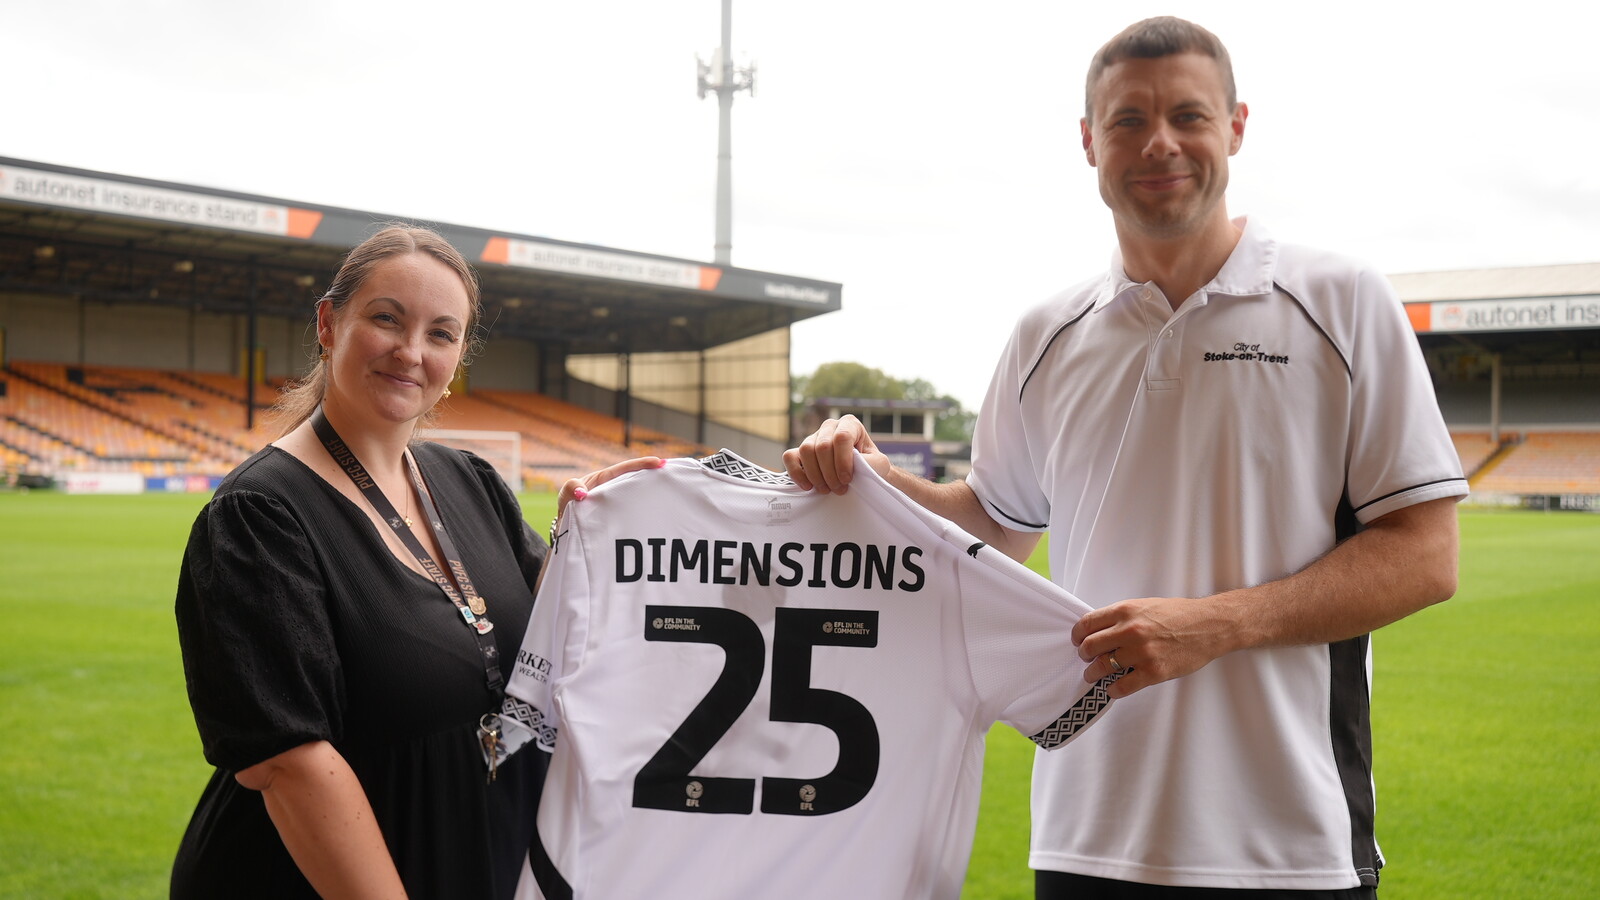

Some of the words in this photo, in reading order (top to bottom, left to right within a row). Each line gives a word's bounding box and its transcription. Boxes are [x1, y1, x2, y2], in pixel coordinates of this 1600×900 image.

[13, 175, 96, 202] autonet
[101, 186, 200, 217] insurance
[205, 202, 258, 226] stand
[1465, 303, 1556, 328] autonet
[1203, 351, 1289, 365] Stoke-on-Trent
[1233, 342, 1249, 353] City
[1250, 343, 1261, 352] of
[348, 465, 375, 490] PVFC
[419, 558, 448, 584] STAFF
[449, 559, 470, 583] PVFC
[615, 537, 926, 593] DIMENSIONS
[664, 623, 701, 631] COMMUNITY
[833, 627, 870, 635] COMMUNITY
[632, 605, 880, 816] 25
[686, 799, 700, 808] EFL
[800, 802, 814, 811] EFL
